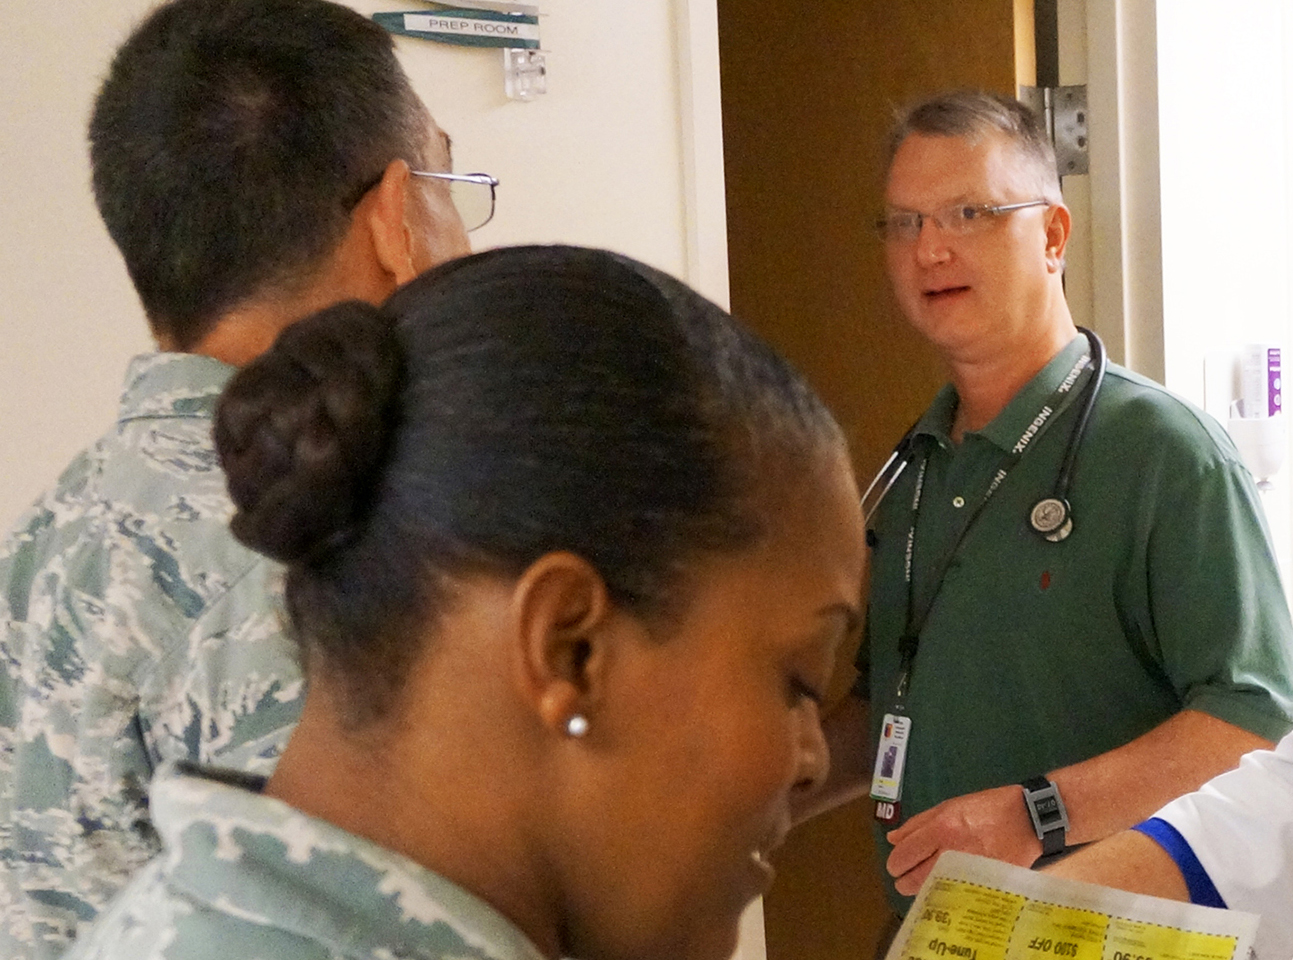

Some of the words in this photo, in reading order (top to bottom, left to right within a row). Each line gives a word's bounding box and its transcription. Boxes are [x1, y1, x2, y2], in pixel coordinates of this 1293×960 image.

[429, 18, 469, 31] PREP
[473, 22, 519, 35] ROOM
[1027, 936, 1053, 953] OFF
